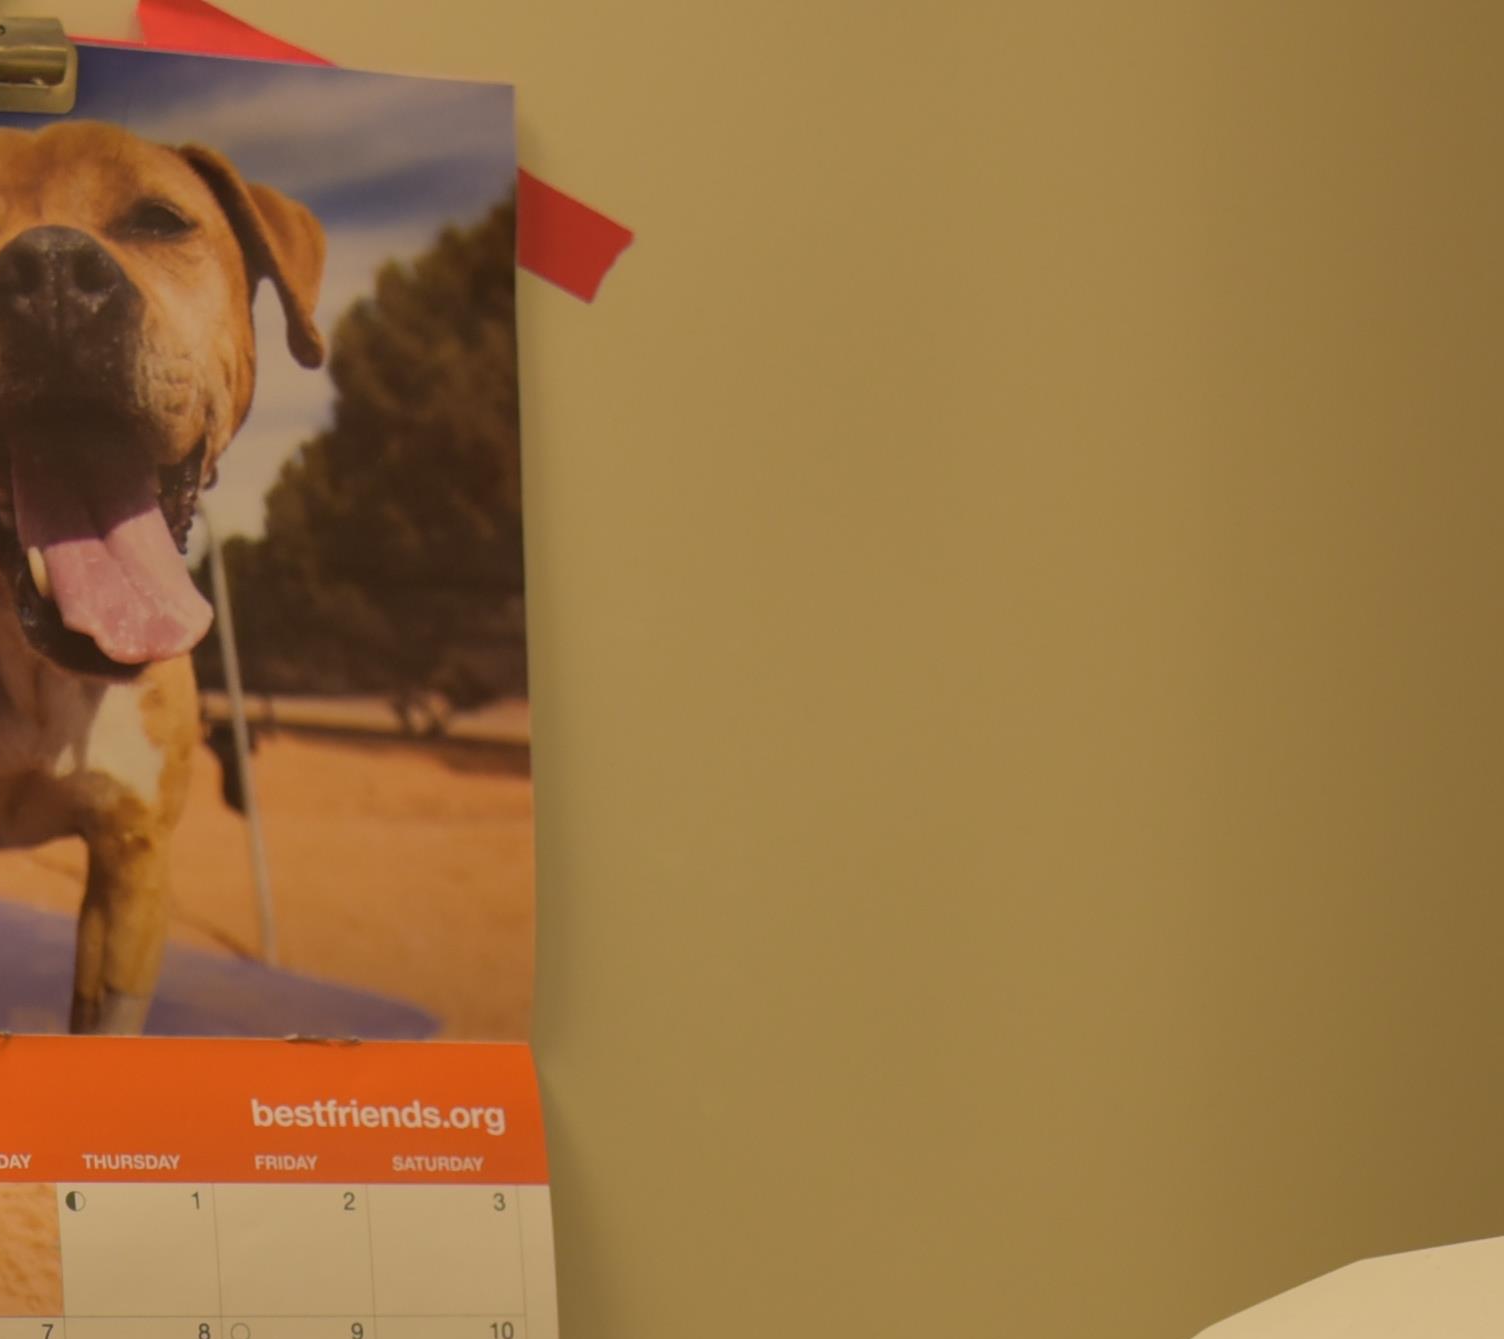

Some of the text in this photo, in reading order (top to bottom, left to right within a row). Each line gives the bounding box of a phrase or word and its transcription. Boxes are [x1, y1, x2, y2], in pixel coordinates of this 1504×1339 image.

[251, 1098, 505, 1136] bestfriends.org
[82, 1153, 180, 1170] THURSDAY
[254, 1155, 318, 1171] FRIDAY
[391, 1155, 484, 1173] SATURDAY
[191, 1191, 506, 1212] 1 2 3
